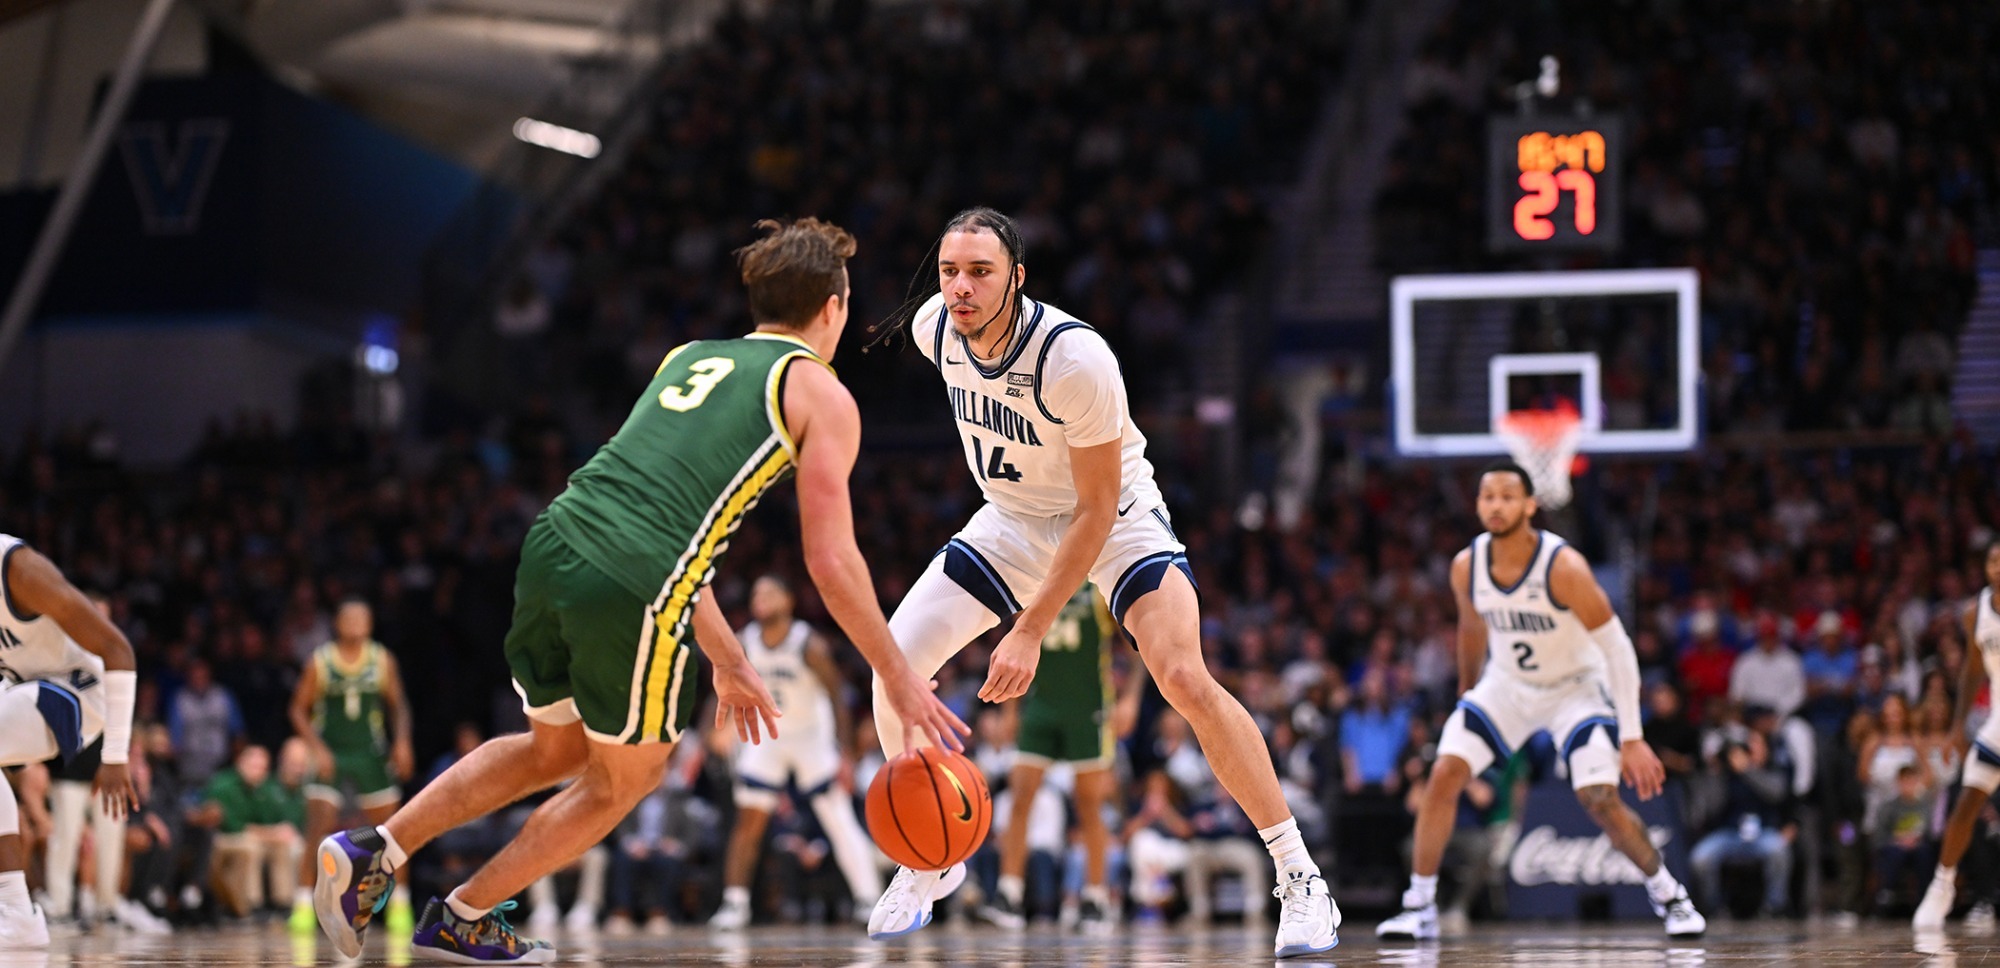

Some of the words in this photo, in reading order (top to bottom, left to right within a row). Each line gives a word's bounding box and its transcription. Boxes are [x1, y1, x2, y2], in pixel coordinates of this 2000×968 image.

[1513, 169, 1596, 240] 27
[658, 356, 735, 413] 3
[949, 386, 1044, 447] VILLANOVA
[971, 434, 1023, 483] 14
[1512, 641, 1539, 671] 2
